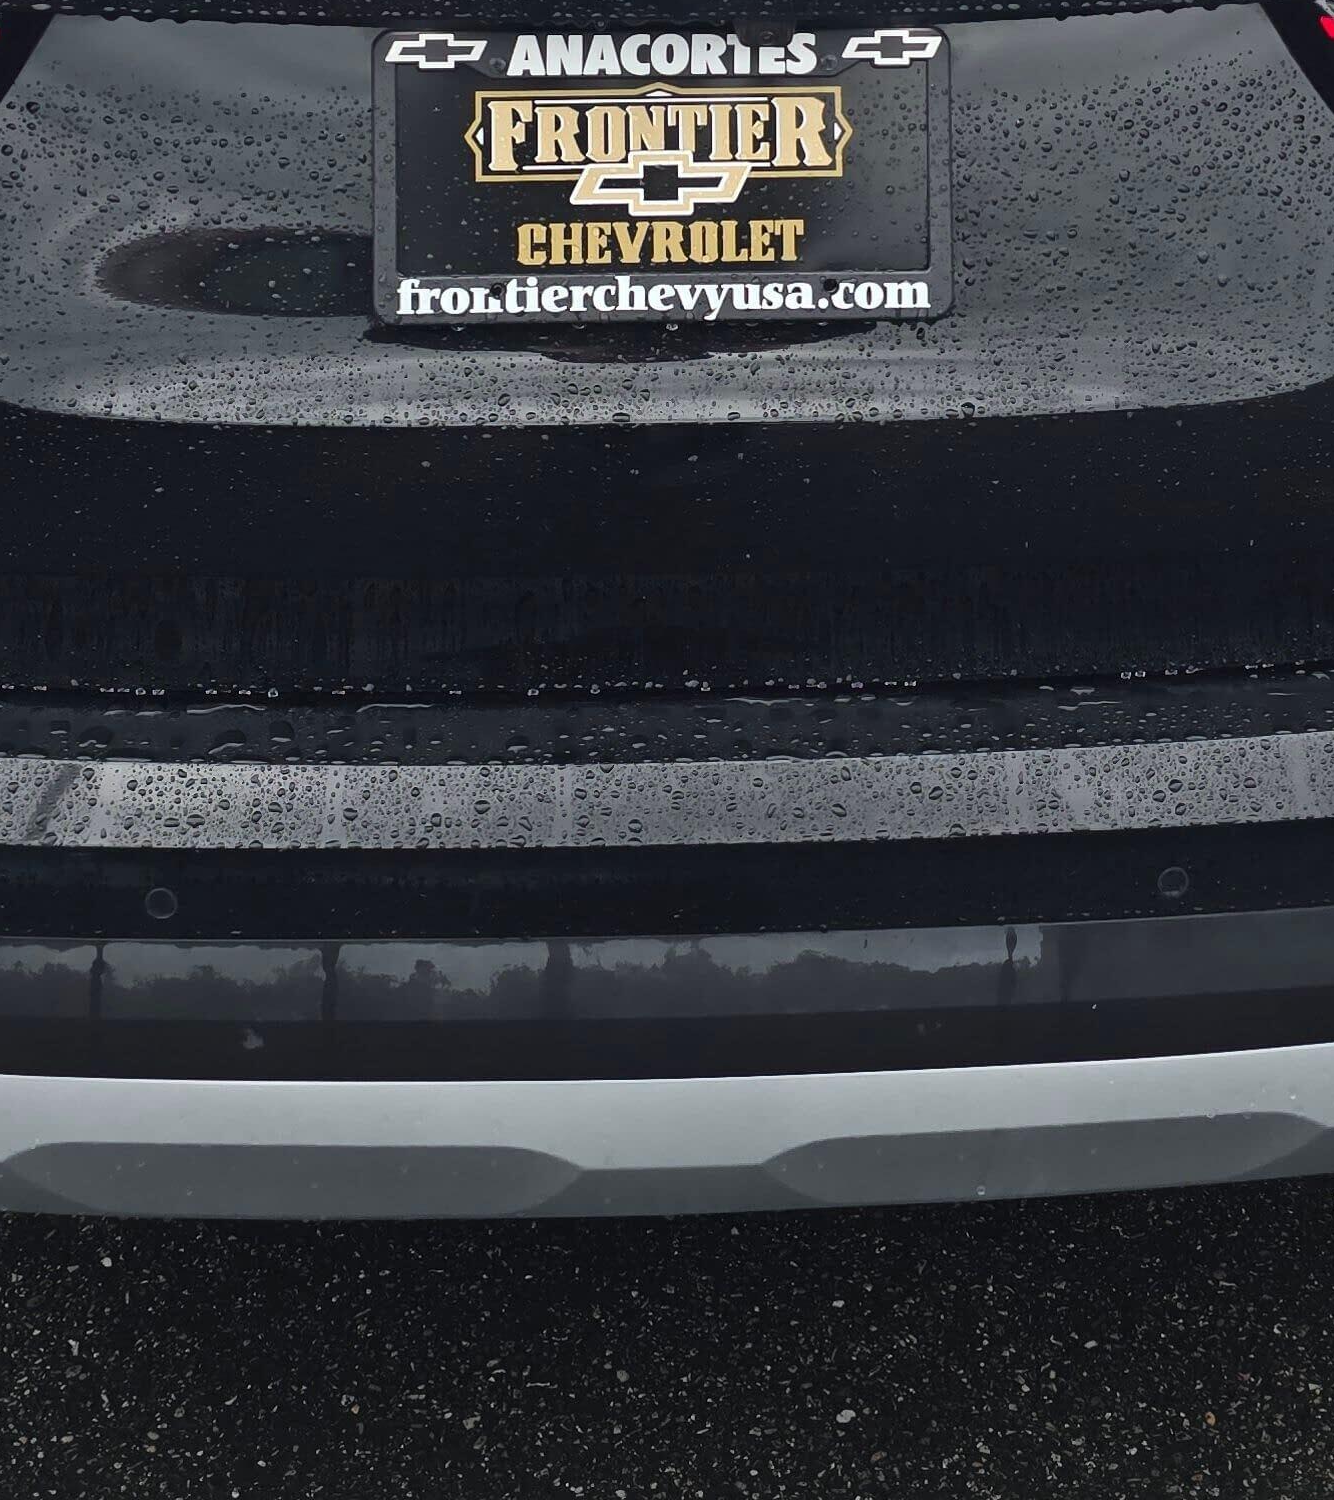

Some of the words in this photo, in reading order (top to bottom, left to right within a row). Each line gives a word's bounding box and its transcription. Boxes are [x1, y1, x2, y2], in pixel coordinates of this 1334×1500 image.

[506, 32, 818, 76] ANACORTES
[487, 97, 833, 172] FRONTIER
[516, 219, 805, 266] CHEVROLET
[396, 275, 931, 320] frontierchevyusa.com
